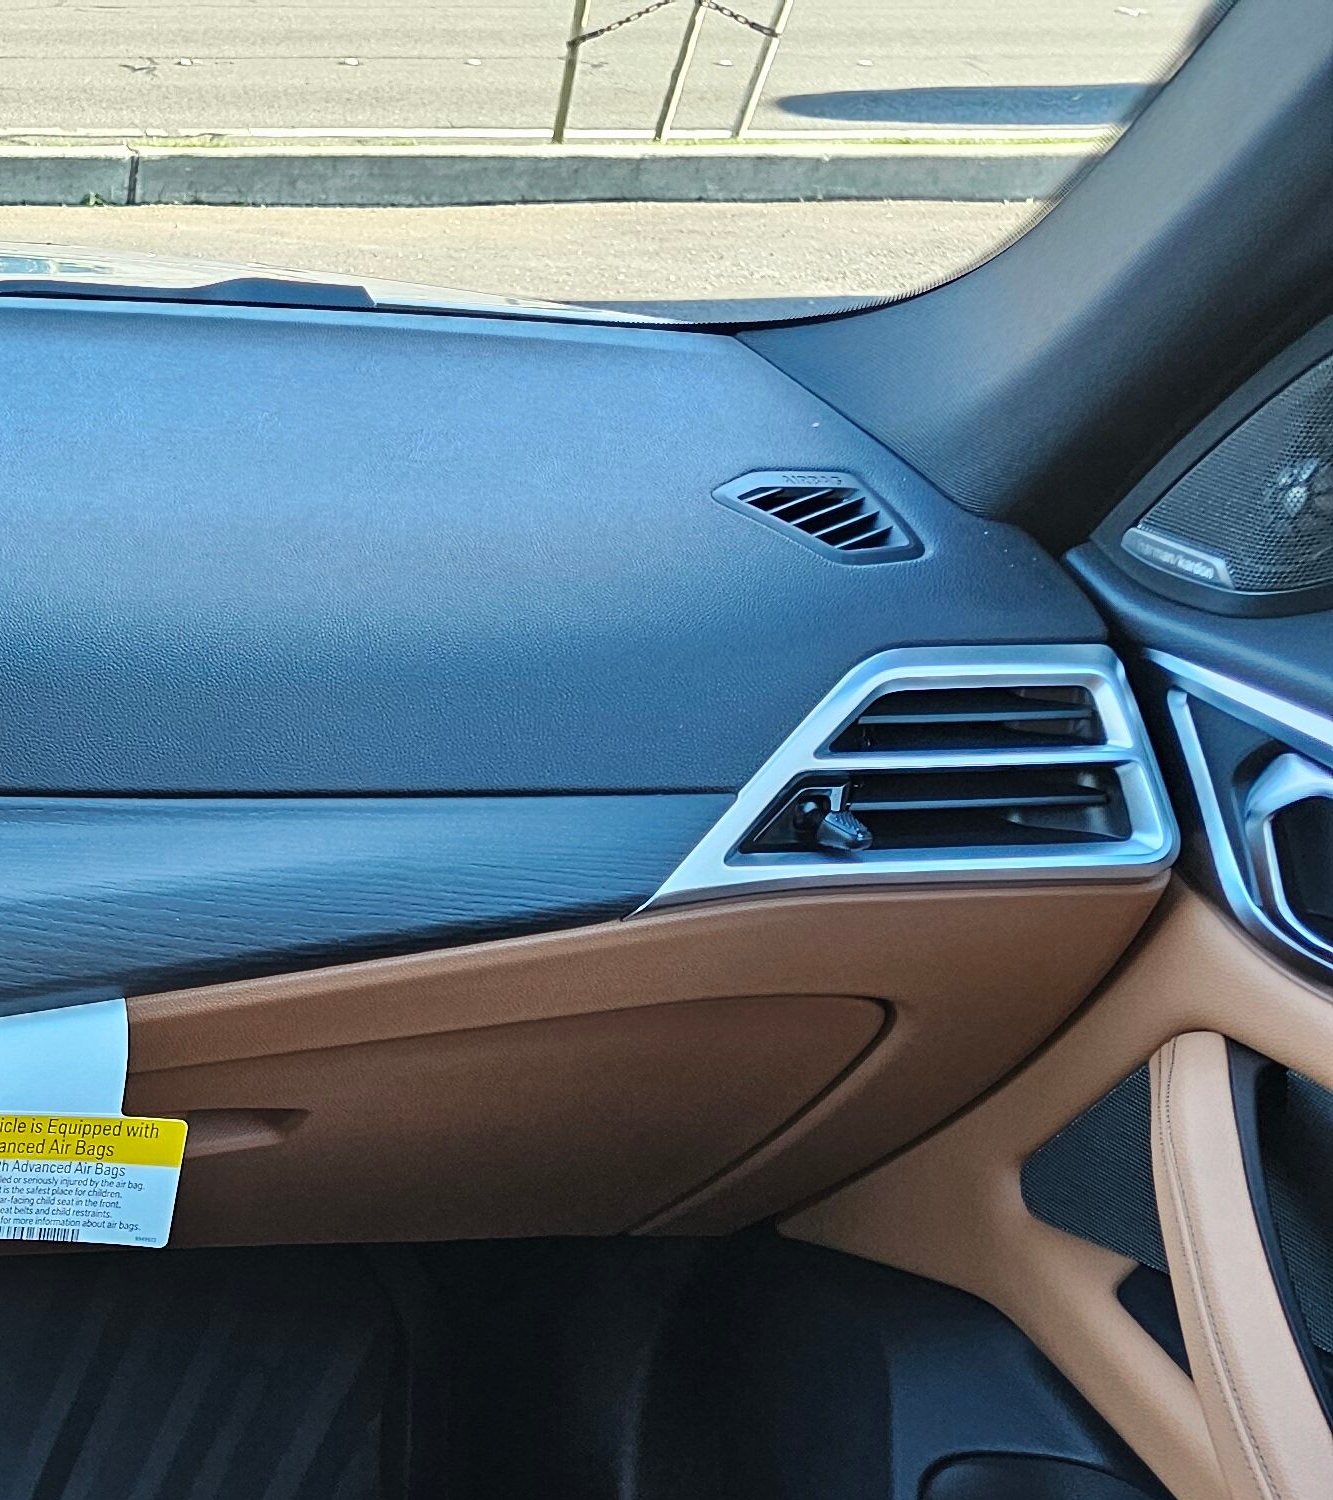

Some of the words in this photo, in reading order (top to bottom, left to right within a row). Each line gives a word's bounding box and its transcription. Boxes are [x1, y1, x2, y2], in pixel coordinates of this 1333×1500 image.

[31, 1118, 42, 1134] is
[48, 1118, 123, 1138] Equipped
[127, 1122, 159, 1138] with
[49, 1139, 71, 1155] Air
[75, 1140, 115, 1160] Bags
[12, 1160, 72, 1174] Advanced
[74, 1162, 92, 1174] Air
[95, 1163, 125, 1179] Bags
[24, 1176, 58, 1186] seriously
[60, 1177, 88, 1187] injured
[90, 1179, 99, 1188] by
[101, 1179, 113, 1187] the
[116, 1180, 126, 1188] air
[128, 1181, 145, 1191] bag.
[12, 1186, 23, 1194] the
[26, 1186, 50, 1195] safest
[52, 1187, 73, 1196] place
[75, 1187, 85, 1196] for
[87, 1189, 122, 1199] children.
[36, 1197, 55, 1205] child
[57, 1198, 74, 1206] seat
[75, 1198, 83, 1206] in
[85, 1198, 97, 1207] the
[14, 1206, 33, 1215] belts
[35, 1207, 49, 1216] and
[52, 1208, 71, 1216] child
[1, 1216, 11, 1224] for
[35, 1217, 81, 1227] information
[82, 1220, 106, 1228] about
[107, 1221, 116, 1229] air
